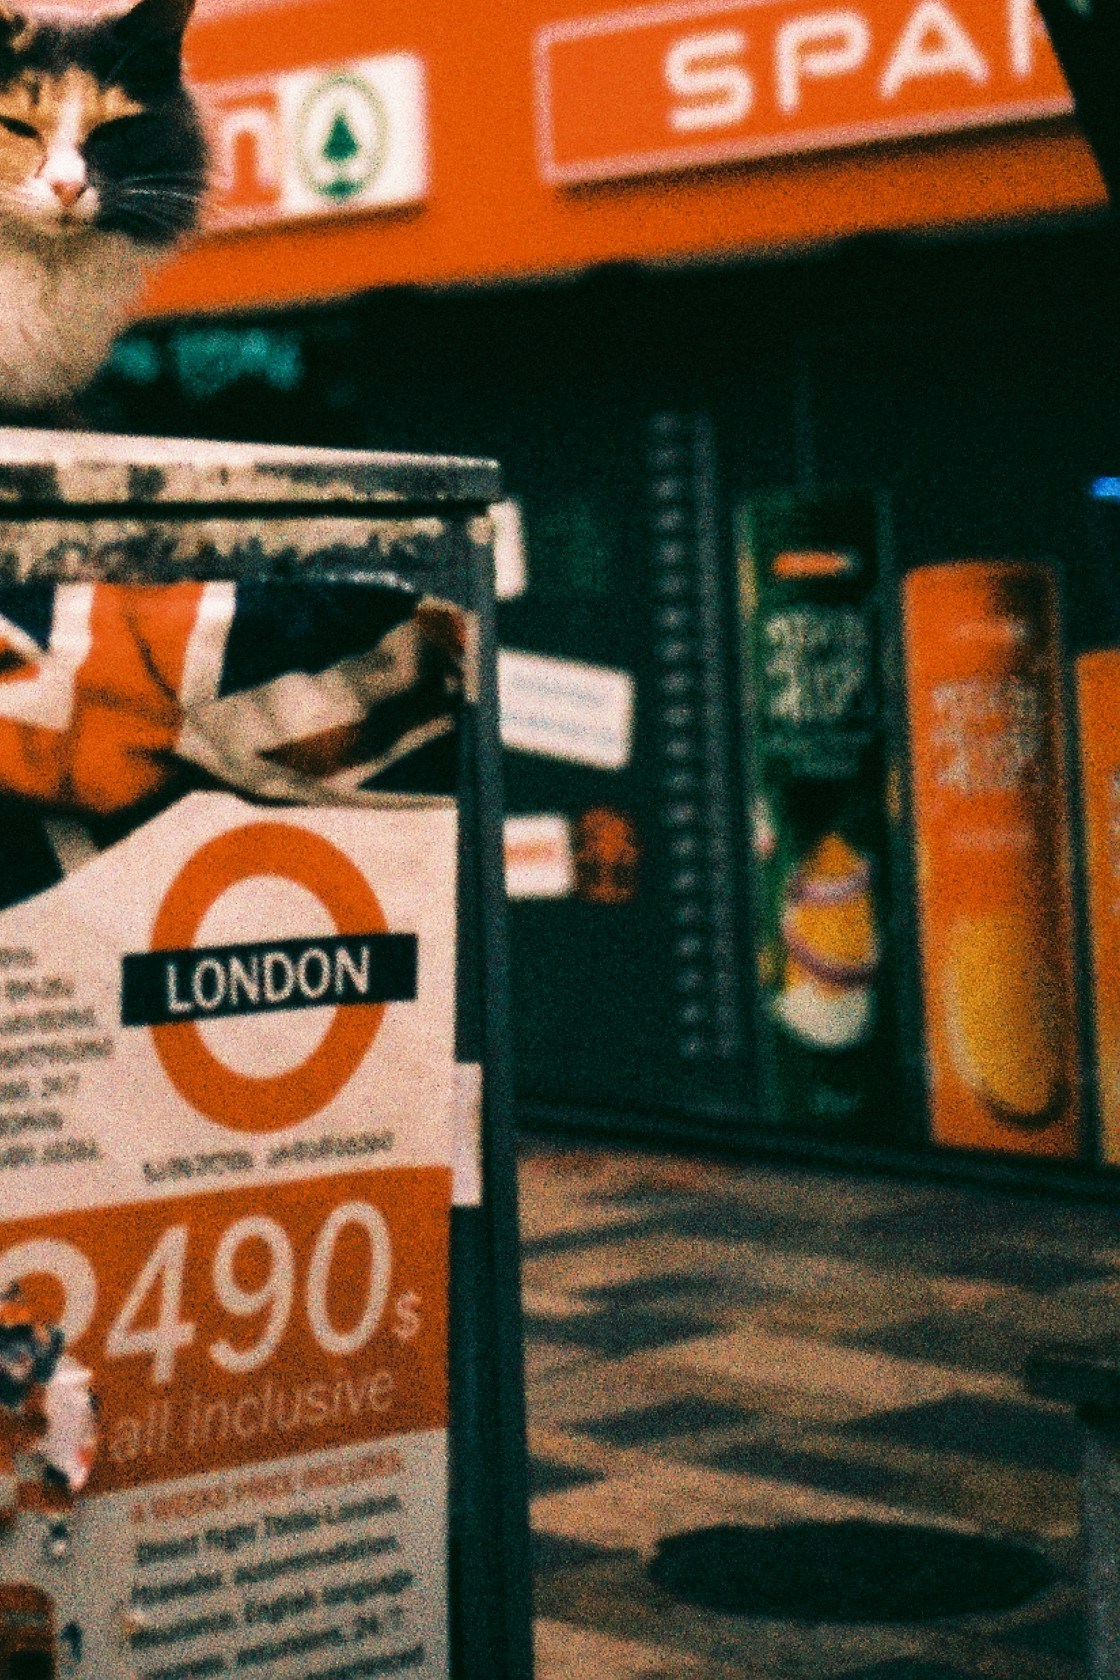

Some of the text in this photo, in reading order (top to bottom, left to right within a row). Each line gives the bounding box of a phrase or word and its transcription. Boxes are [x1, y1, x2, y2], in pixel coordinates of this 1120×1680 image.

[164, 946, 373, 1014] LONDON
[110, 1367, 396, 1464] all inclusive
